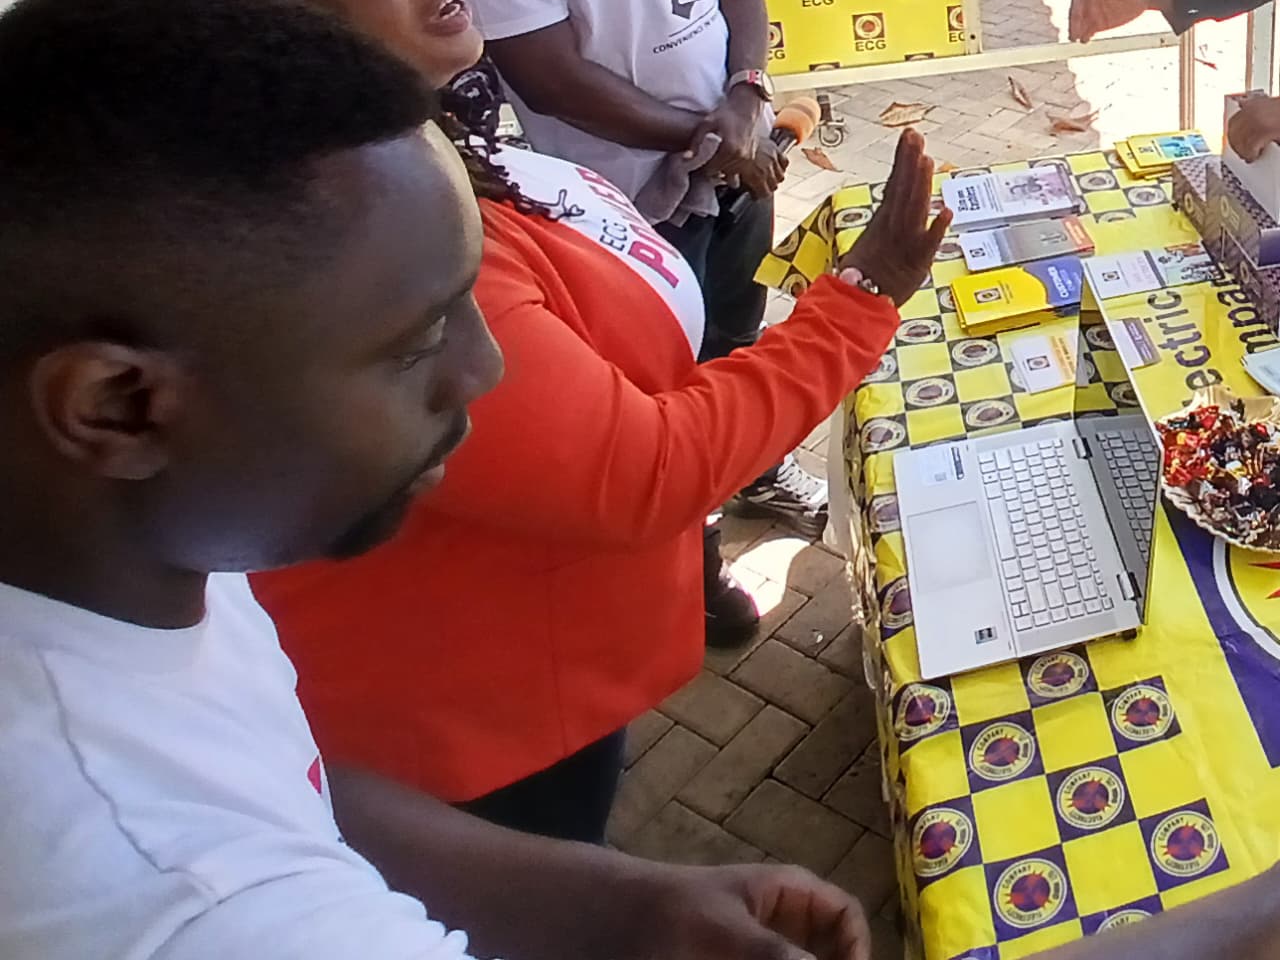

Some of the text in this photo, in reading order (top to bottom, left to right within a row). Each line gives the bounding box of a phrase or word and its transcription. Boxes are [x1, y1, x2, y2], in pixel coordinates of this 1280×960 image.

[855, 39, 887, 52] ECG
[949, 32, 965, 43] EC
[1143, 290, 1223, 391] ectric
[977, 728, 1004, 751] COMPANY
[1063, 771, 1091, 794] COMPANY
[1158, 817, 1184, 841] COMPANY
[1002, 864, 1032, 889] COMPANY
